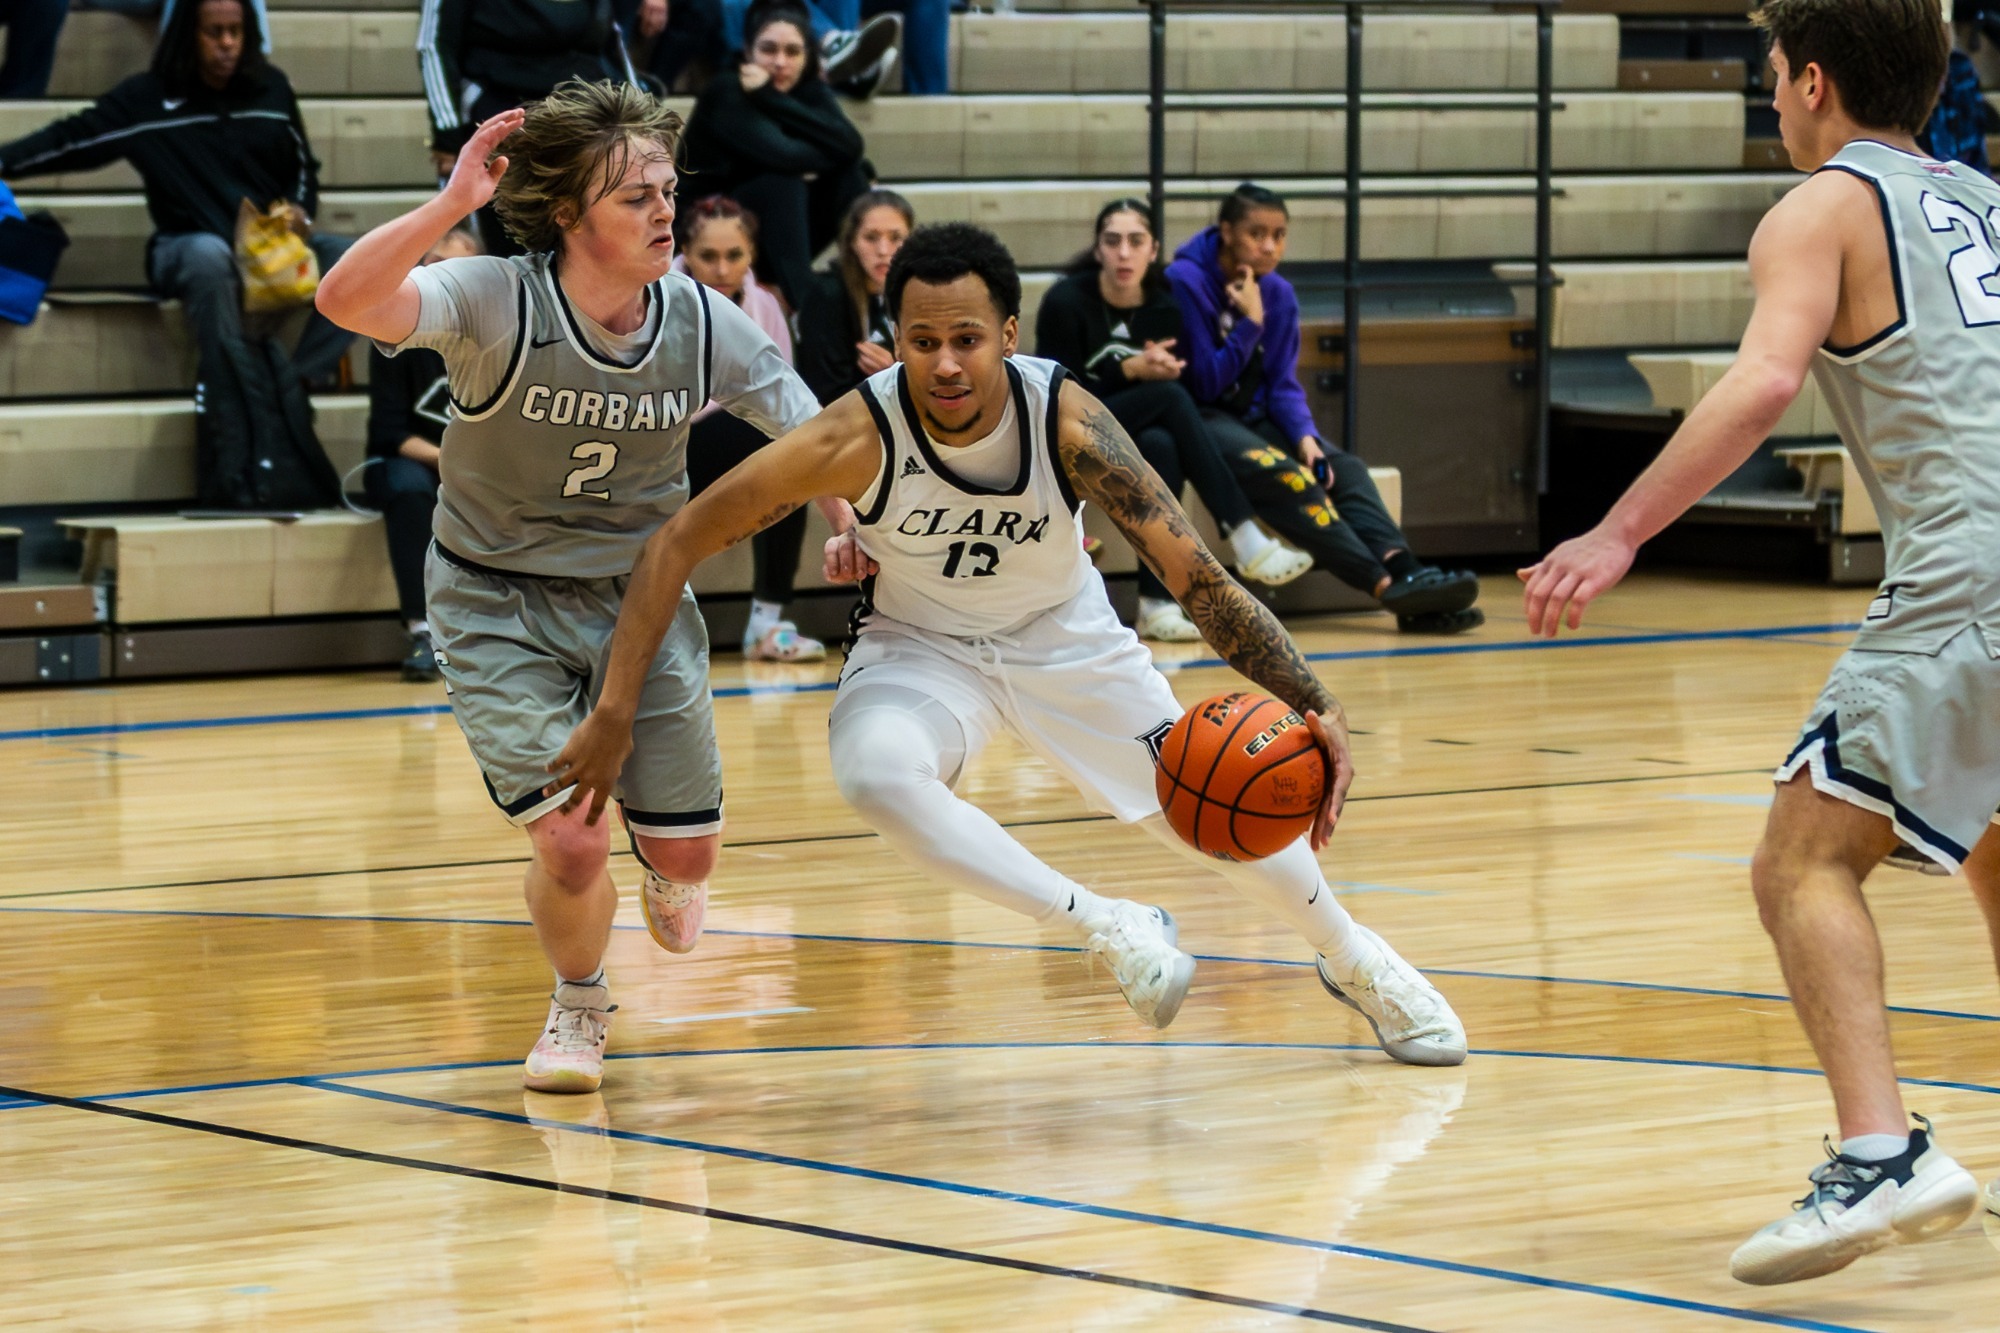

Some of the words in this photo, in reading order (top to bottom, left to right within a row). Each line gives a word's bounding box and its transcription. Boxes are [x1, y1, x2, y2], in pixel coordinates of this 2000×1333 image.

[1920, 190, 2000, 328] 2
[520, 383, 689, 431] CORBAN
[560, 439, 620, 501] 2
[897, 508, 1049, 544] CLARK
[1243, 711, 1303, 758] ELITE
